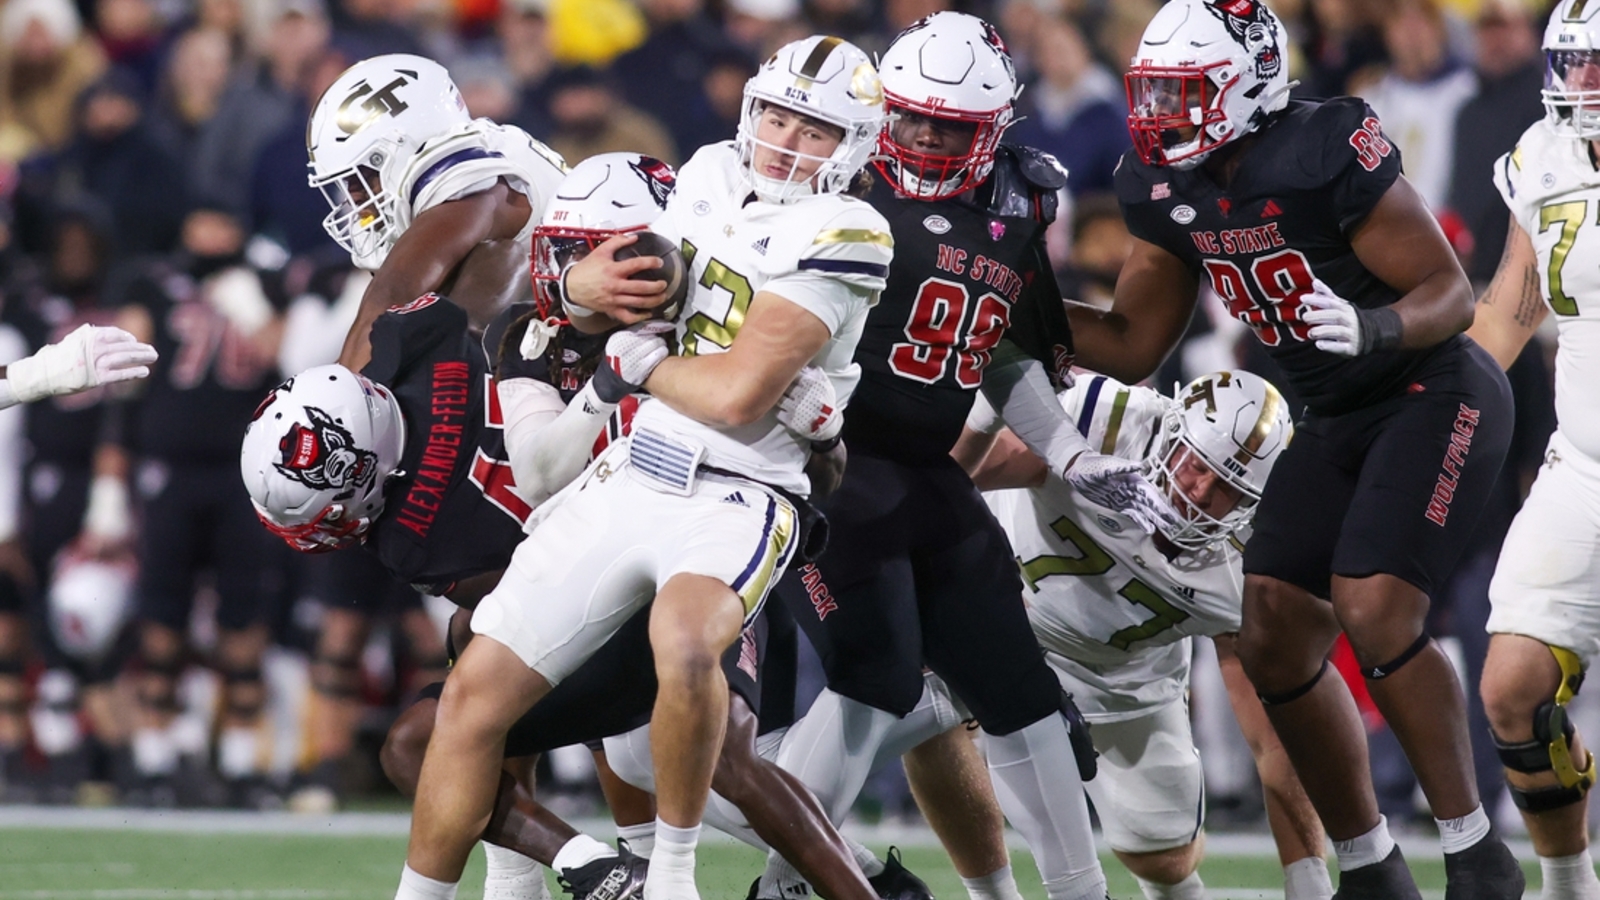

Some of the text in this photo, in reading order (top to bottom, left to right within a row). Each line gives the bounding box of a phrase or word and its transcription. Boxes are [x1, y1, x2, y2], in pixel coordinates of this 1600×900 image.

[935, 243, 1024, 304] NC STATE
[1190, 221, 1286, 254] NC STATE
[1537, 199, 1600, 316] 7
[396, 361, 470, 538] ALEXANDER-FELTON
[1425, 402, 1481, 527] WOLFPACK
[1015, 514, 1191, 652] 77
